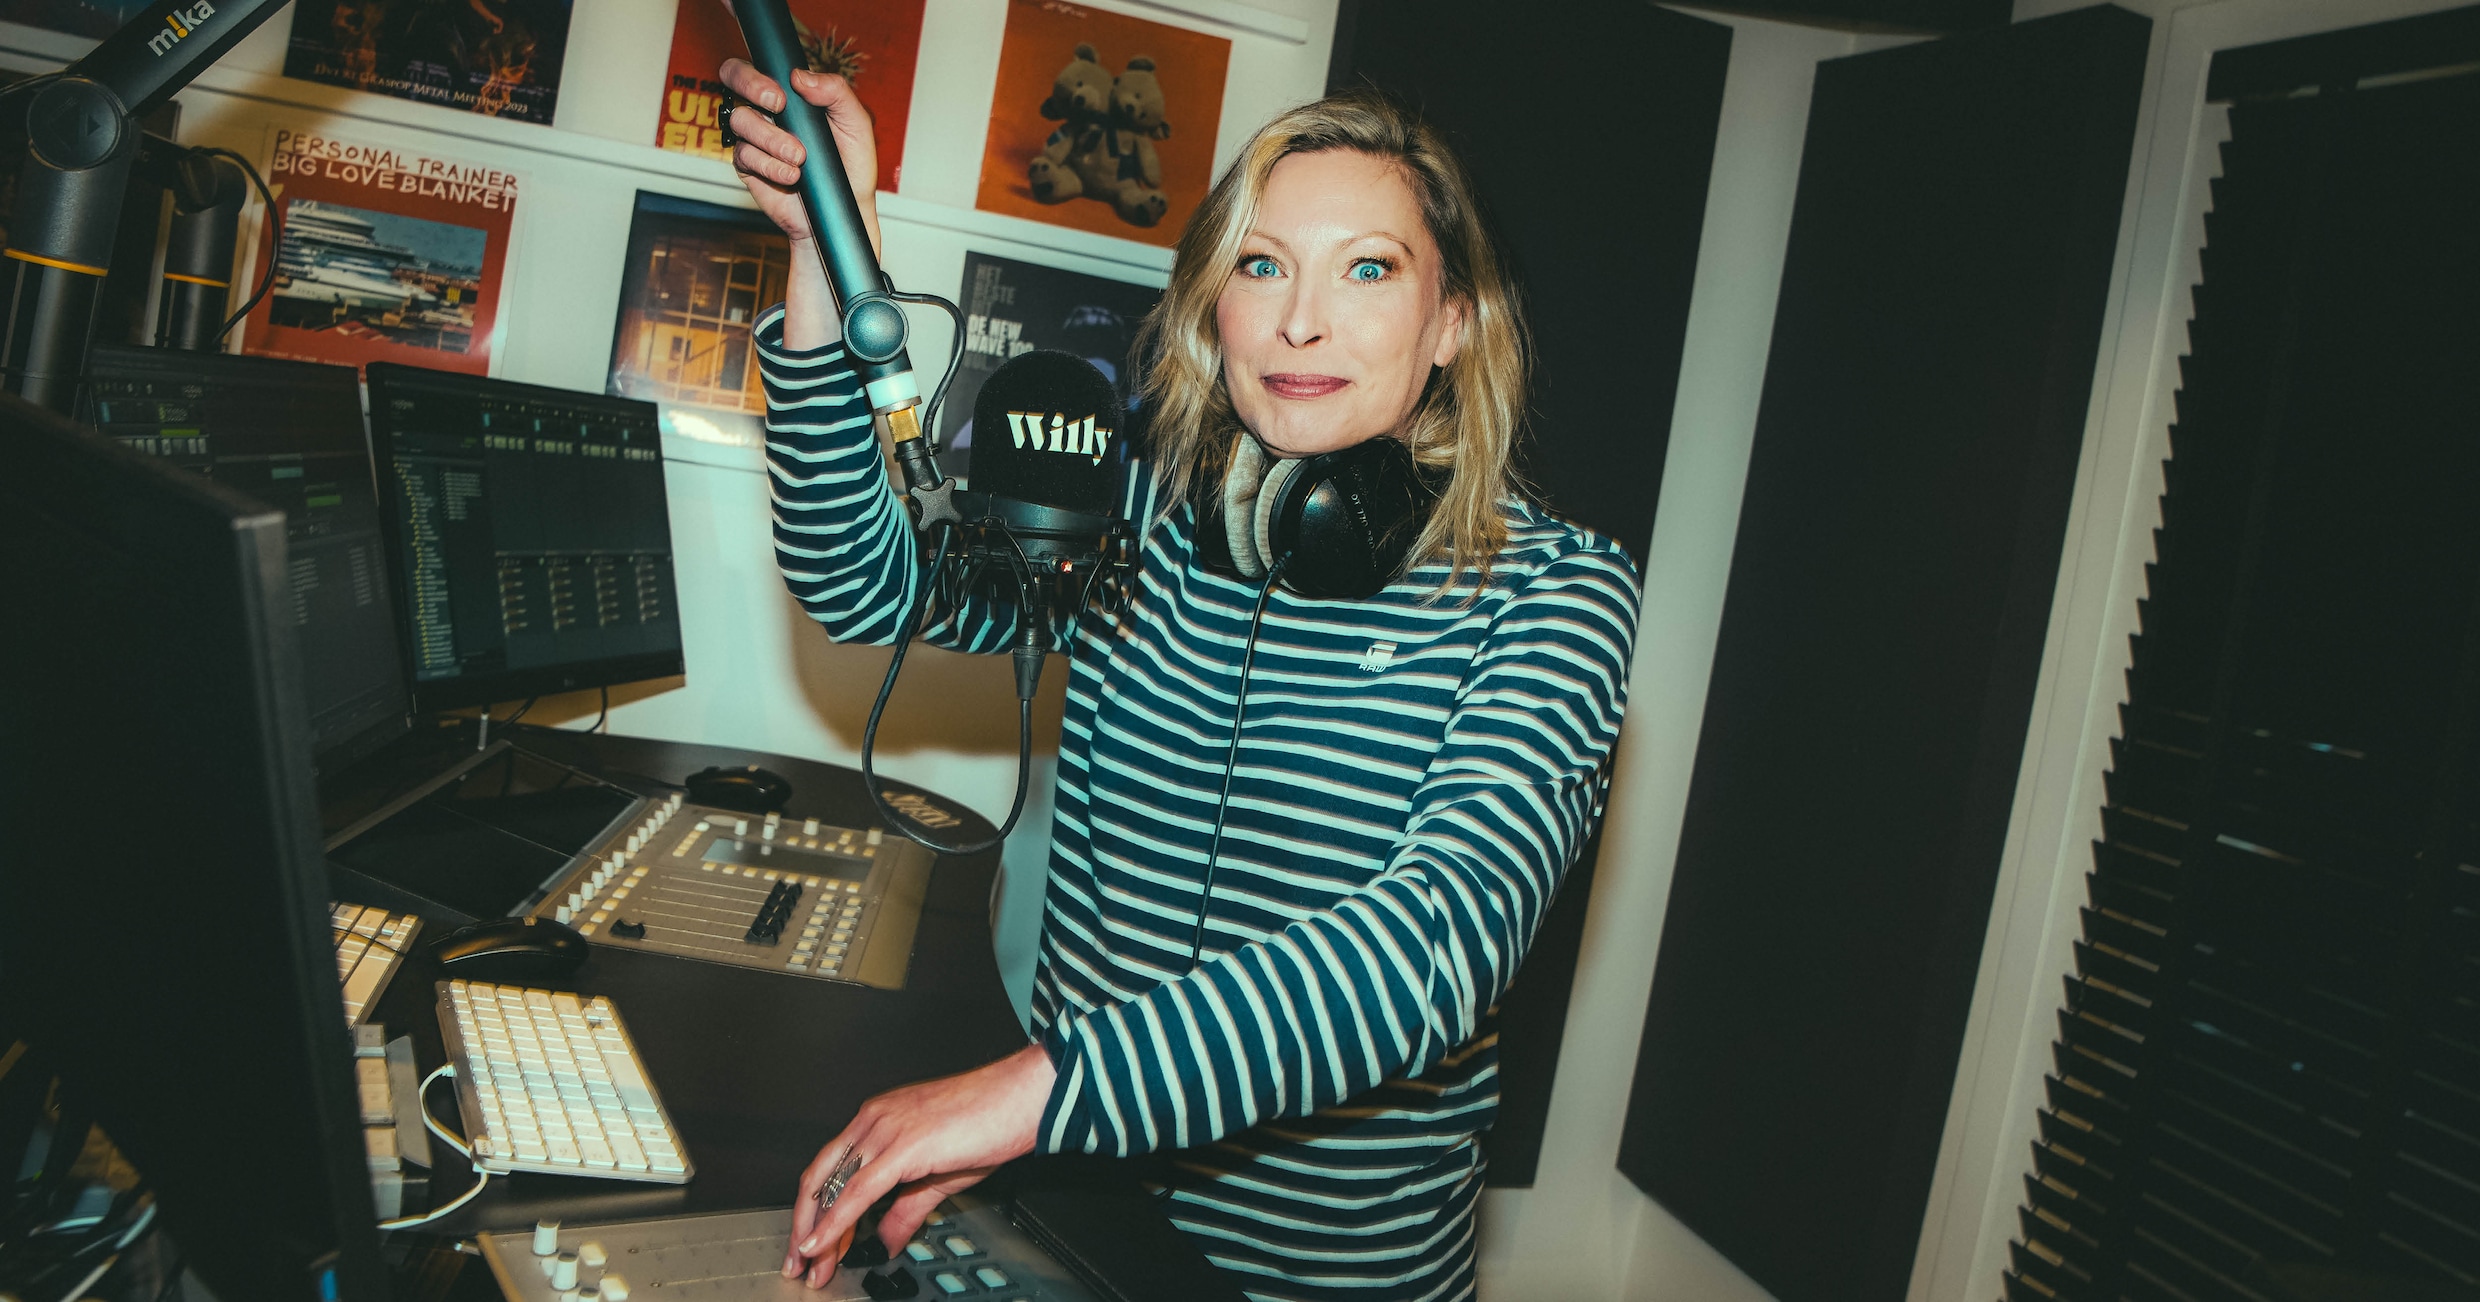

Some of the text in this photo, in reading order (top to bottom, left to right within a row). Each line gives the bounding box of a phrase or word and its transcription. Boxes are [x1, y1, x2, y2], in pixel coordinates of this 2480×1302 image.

[276, 129, 519, 191] PERSONAL TRAINER
[273, 152, 518, 213] BIG LOVE BLANKET
[965, 333, 1006, 358] WAVE
[989, 317, 1023, 341] NEW
[1006, 410, 1113, 467] Willy
[1358, 663, 1387, 673] RAW
